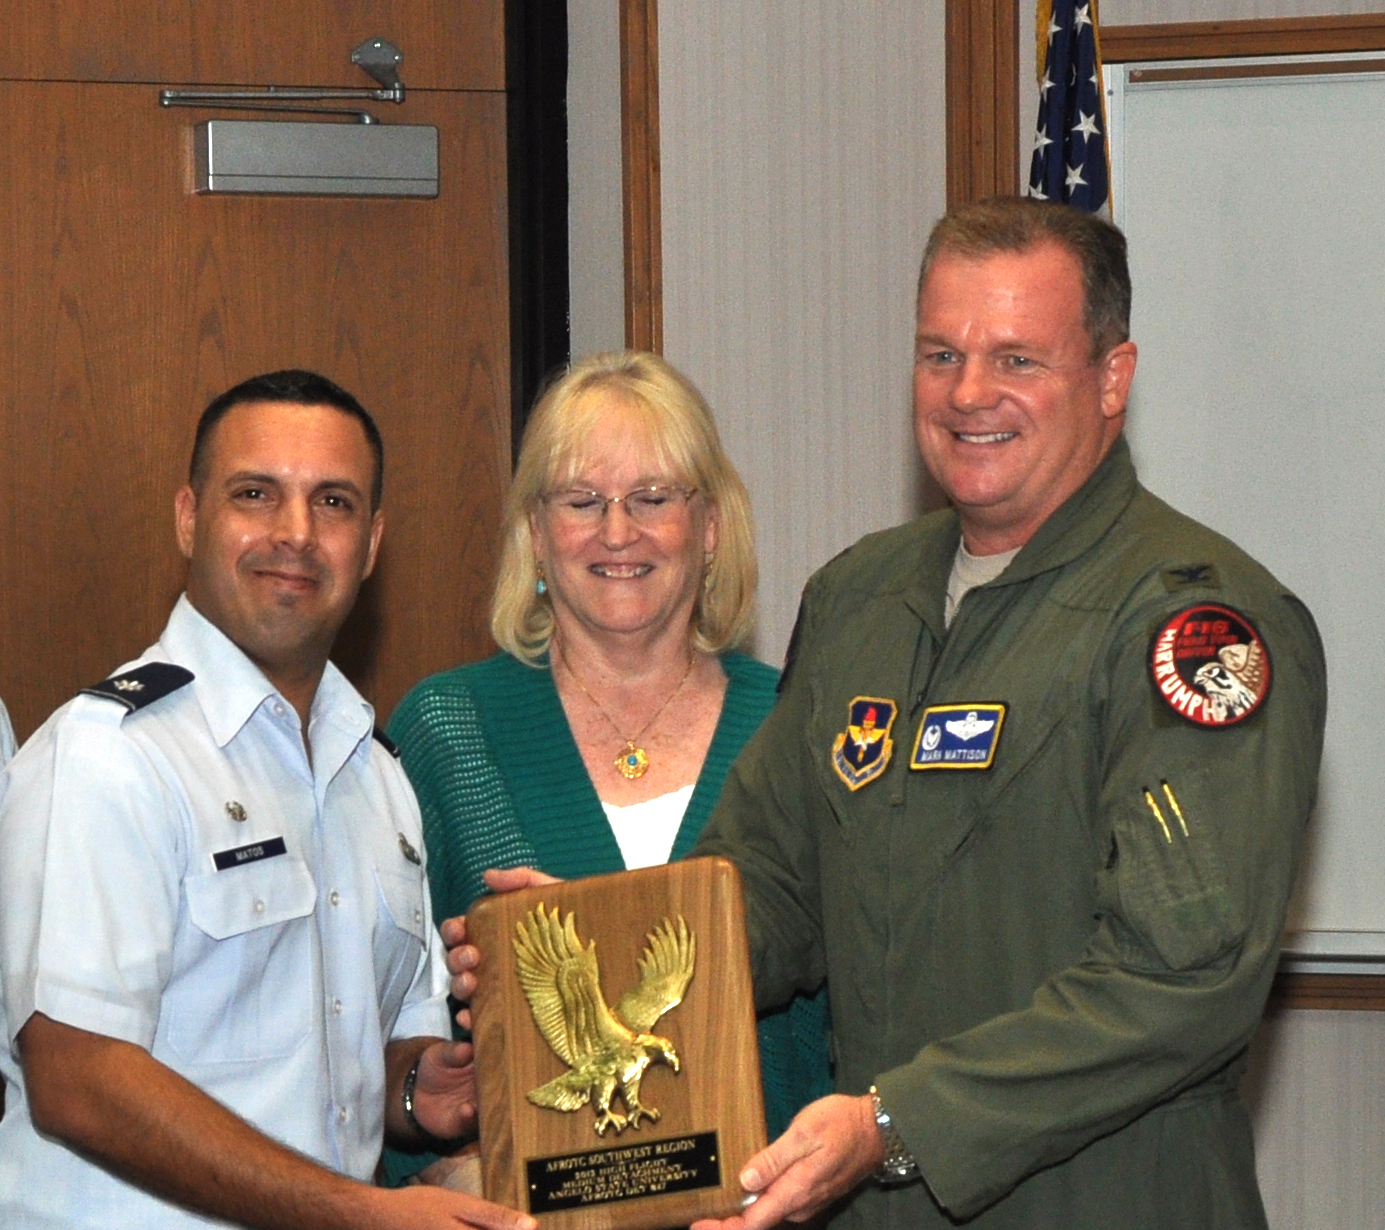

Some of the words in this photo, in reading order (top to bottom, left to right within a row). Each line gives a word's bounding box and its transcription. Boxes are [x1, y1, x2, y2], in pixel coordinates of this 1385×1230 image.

[1156, 629, 1217, 721] HARRUMPH
[944, 749, 987, 761] MATTISON
[235, 845, 265, 862] MATOS
[546, 1156, 587, 1172] AFROTC
[589, 1147, 652, 1165] SOUTHWEST
[656, 1139, 697, 1153] REGION
[631, 1169, 698, 1186] UNIVERSITY
